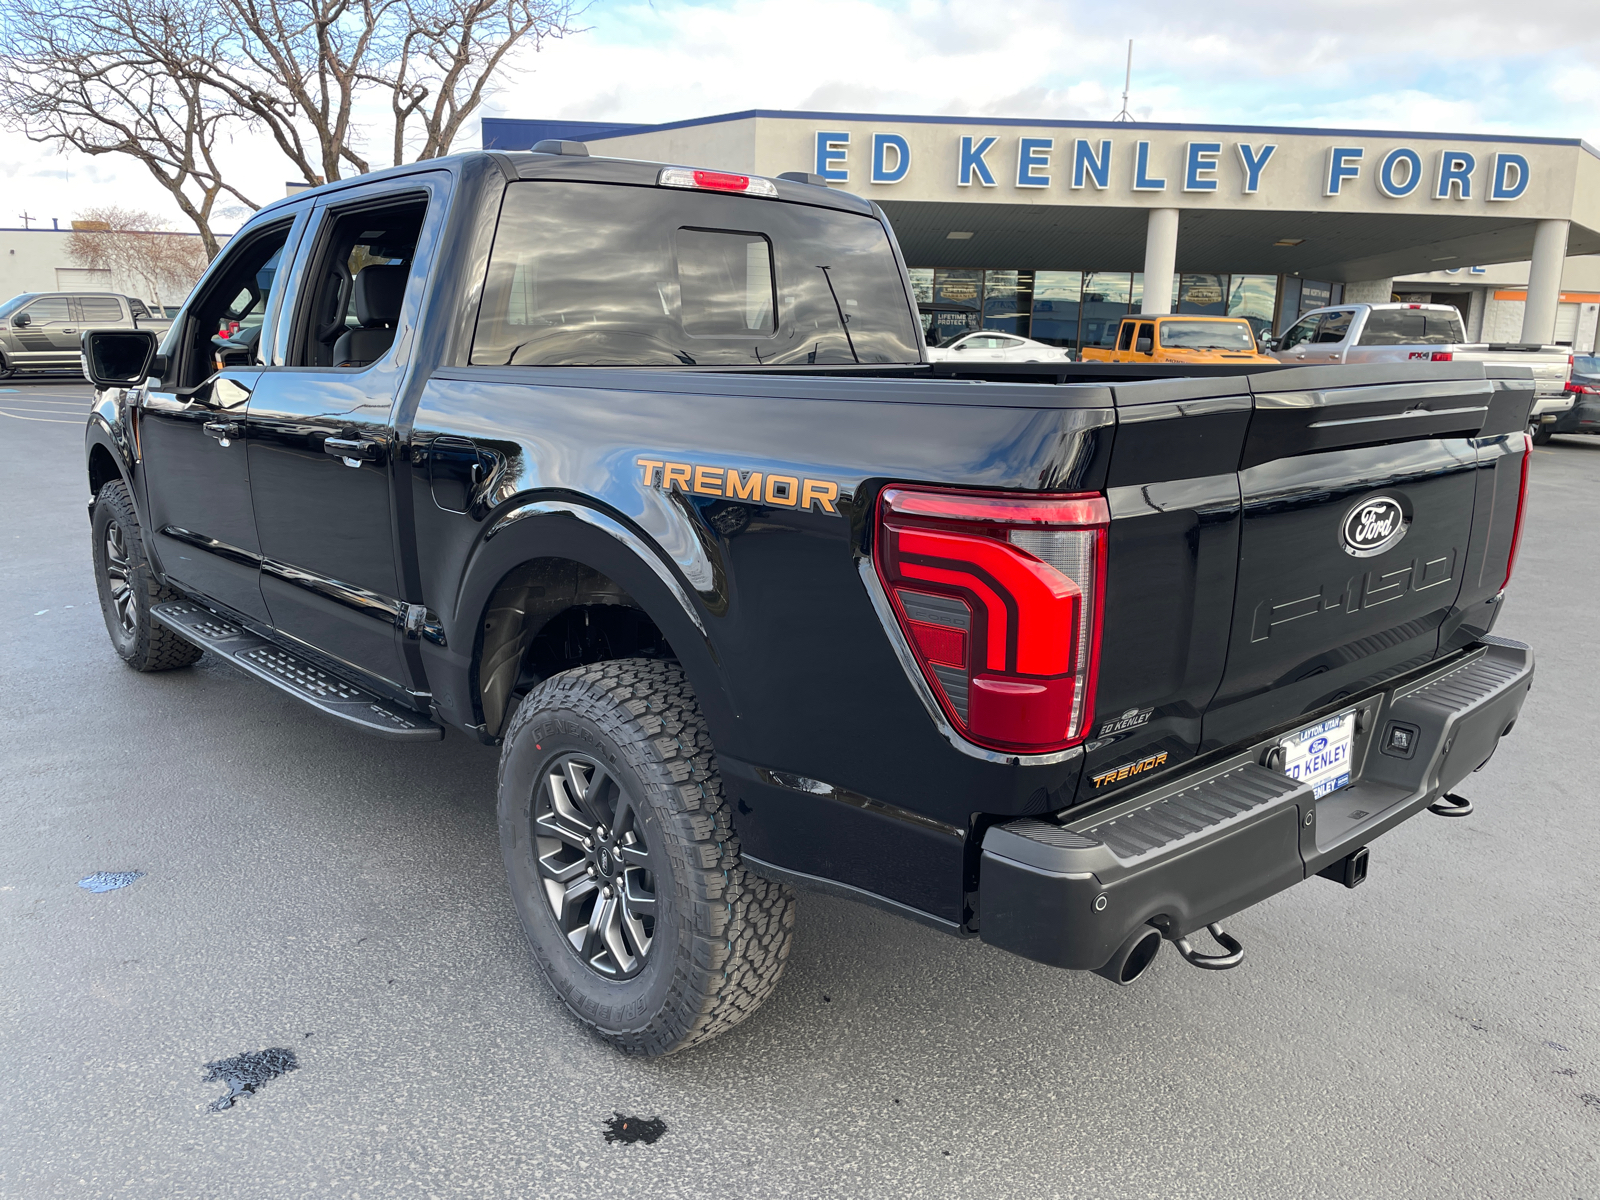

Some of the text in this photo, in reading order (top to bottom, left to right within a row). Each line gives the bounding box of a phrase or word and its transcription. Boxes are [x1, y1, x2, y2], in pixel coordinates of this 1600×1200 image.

[814, 130, 1531, 202] ED KENLEY FORD
[1409, 351, 1430, 360] FX4
[636, 458, 841, 515] TREMOR
[1353, 503, 1397, 544] Ford
[1251, 546, 1457, 643] F-150
[915, 611, 966, 626] FORD
[1101, 725, 1112, 735] ED
[1115, 711, 1152, 731] KENLEY
[1325, 717, 1340, 731] UTAH
[1093, 753, 1168, 788] TREMOR
[1304, 742, 1348, 776] KENLEY
[1314, 779, 1337, 798] ENLEY
